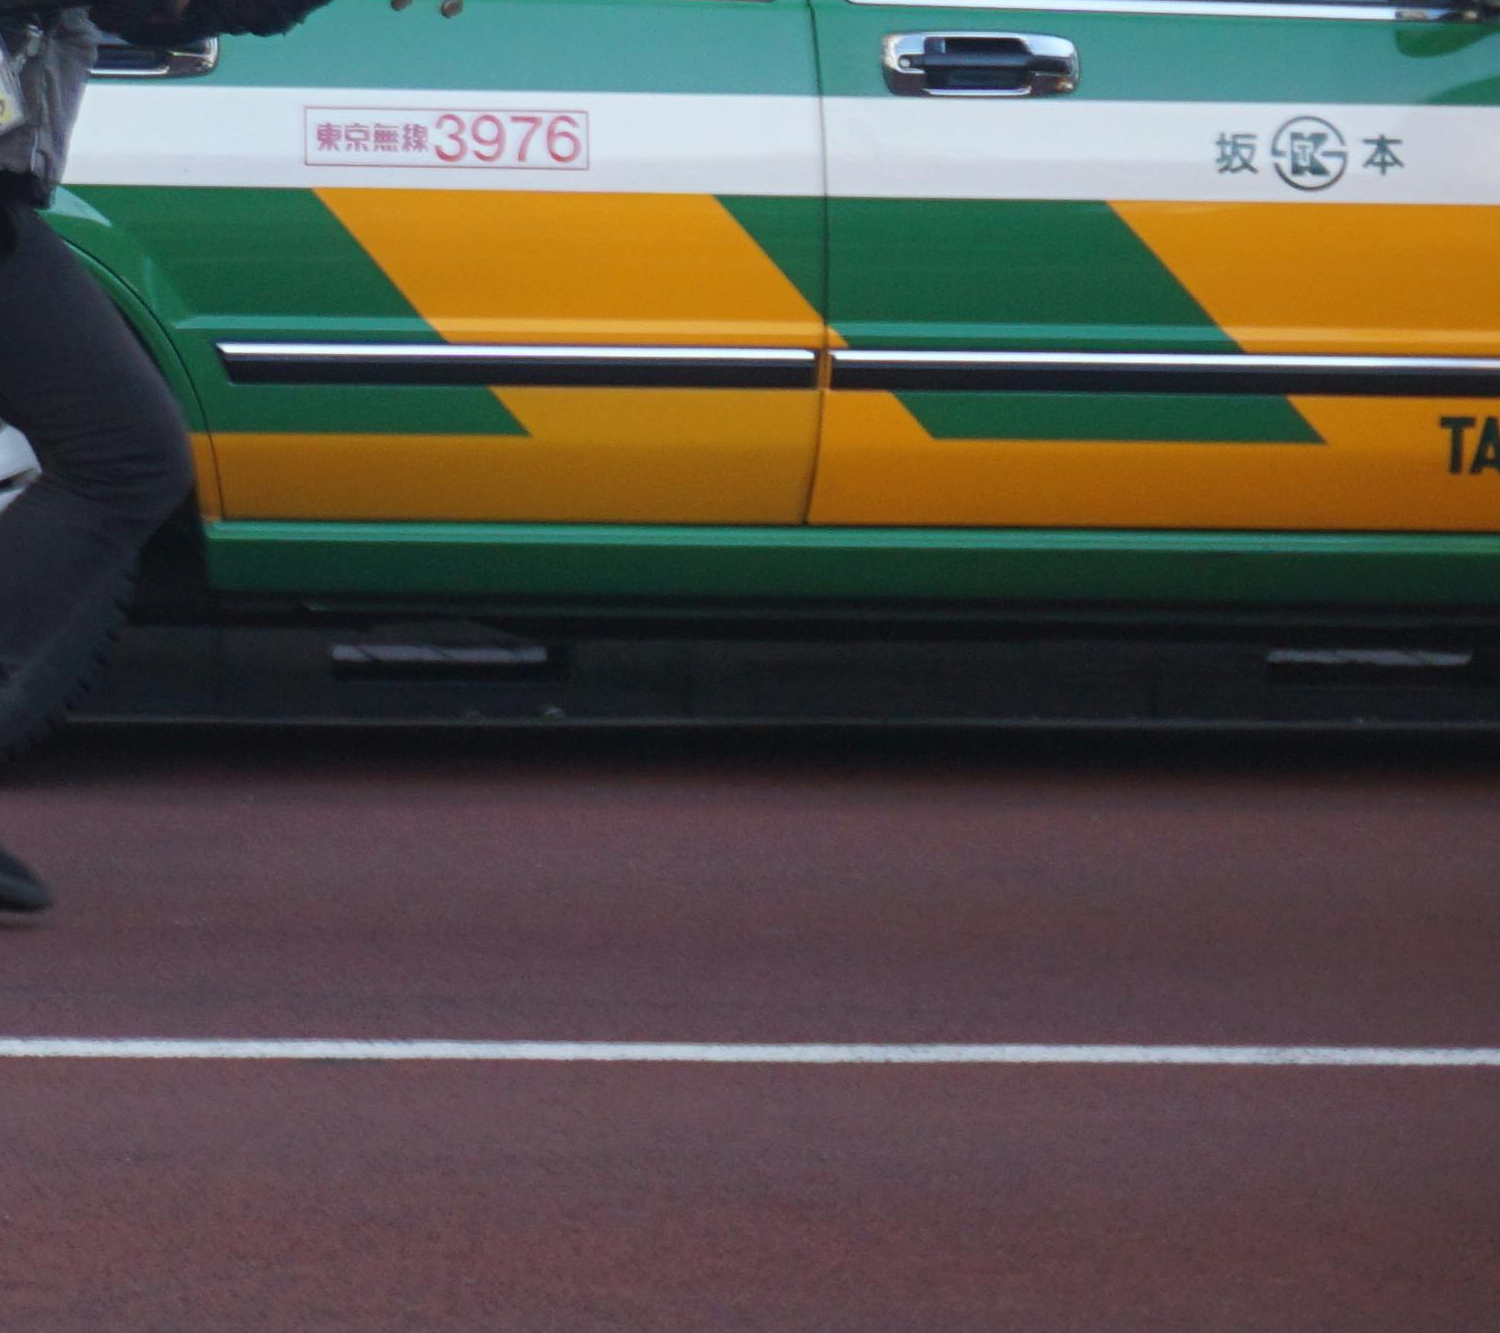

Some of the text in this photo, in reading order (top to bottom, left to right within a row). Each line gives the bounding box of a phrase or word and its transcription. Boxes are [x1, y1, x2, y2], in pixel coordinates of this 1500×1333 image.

[315, 113, 583, 164] 東京無線 3976
